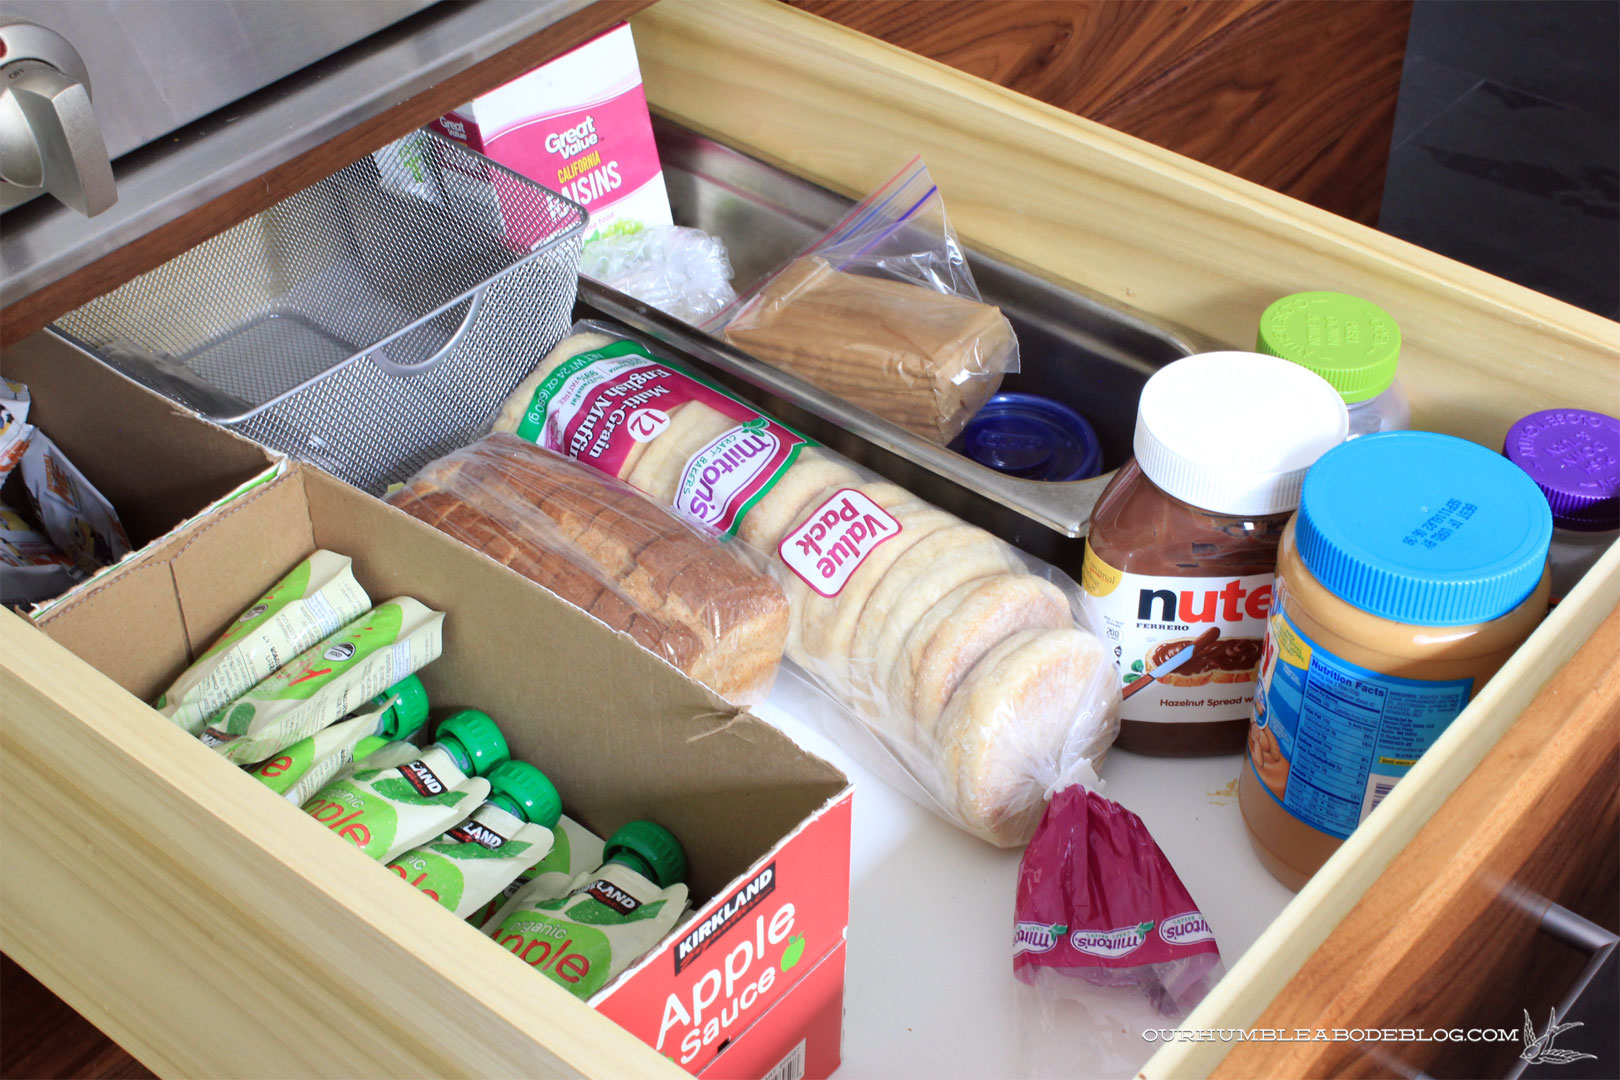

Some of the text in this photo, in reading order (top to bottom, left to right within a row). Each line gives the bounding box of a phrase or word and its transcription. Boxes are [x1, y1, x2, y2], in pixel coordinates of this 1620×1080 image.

[439, 116, 466, 134] Great
[447, 128, 467, 141] Value
[545, 115, 597, 153] Great
[559, 133, 599, 160] Value
[555, 160, 622, 208] AISINS
[557, 151, 601, 184] CALIFORNIA
[559, 366, 572, 379] 24
[604, 368, 673, 397] English
[588, 384, 671, 458] Multi-Grain
[630, 410, 667, 437] 12
[683, 433, 737, 494] CRAFT BAKERS
[690, 433, 772, 519] milton's
[795, 497, 860, 556] Pack
[816, 513, 888, 579] Value
[1137, 579, 1272, 623] nute
[1136, 622, 1189, 632] FERRERO
[1311, 658, 1352, 687] Nutrition
[1355, 681, 1385, 698] Facts
[1160, 697, 1205, 707] Hazelnut
[1207, 697, 1242, 707] Spread
[408, 760, 442, 794] LAND
[463, 822, 502, 848] LAND
[510, 920, 567, 939] organic
[679, 868, 774, 960] KIRKLAND
[1078, 935, 1138, 949] milton's
[655, 903, 795, 1051] Apple
